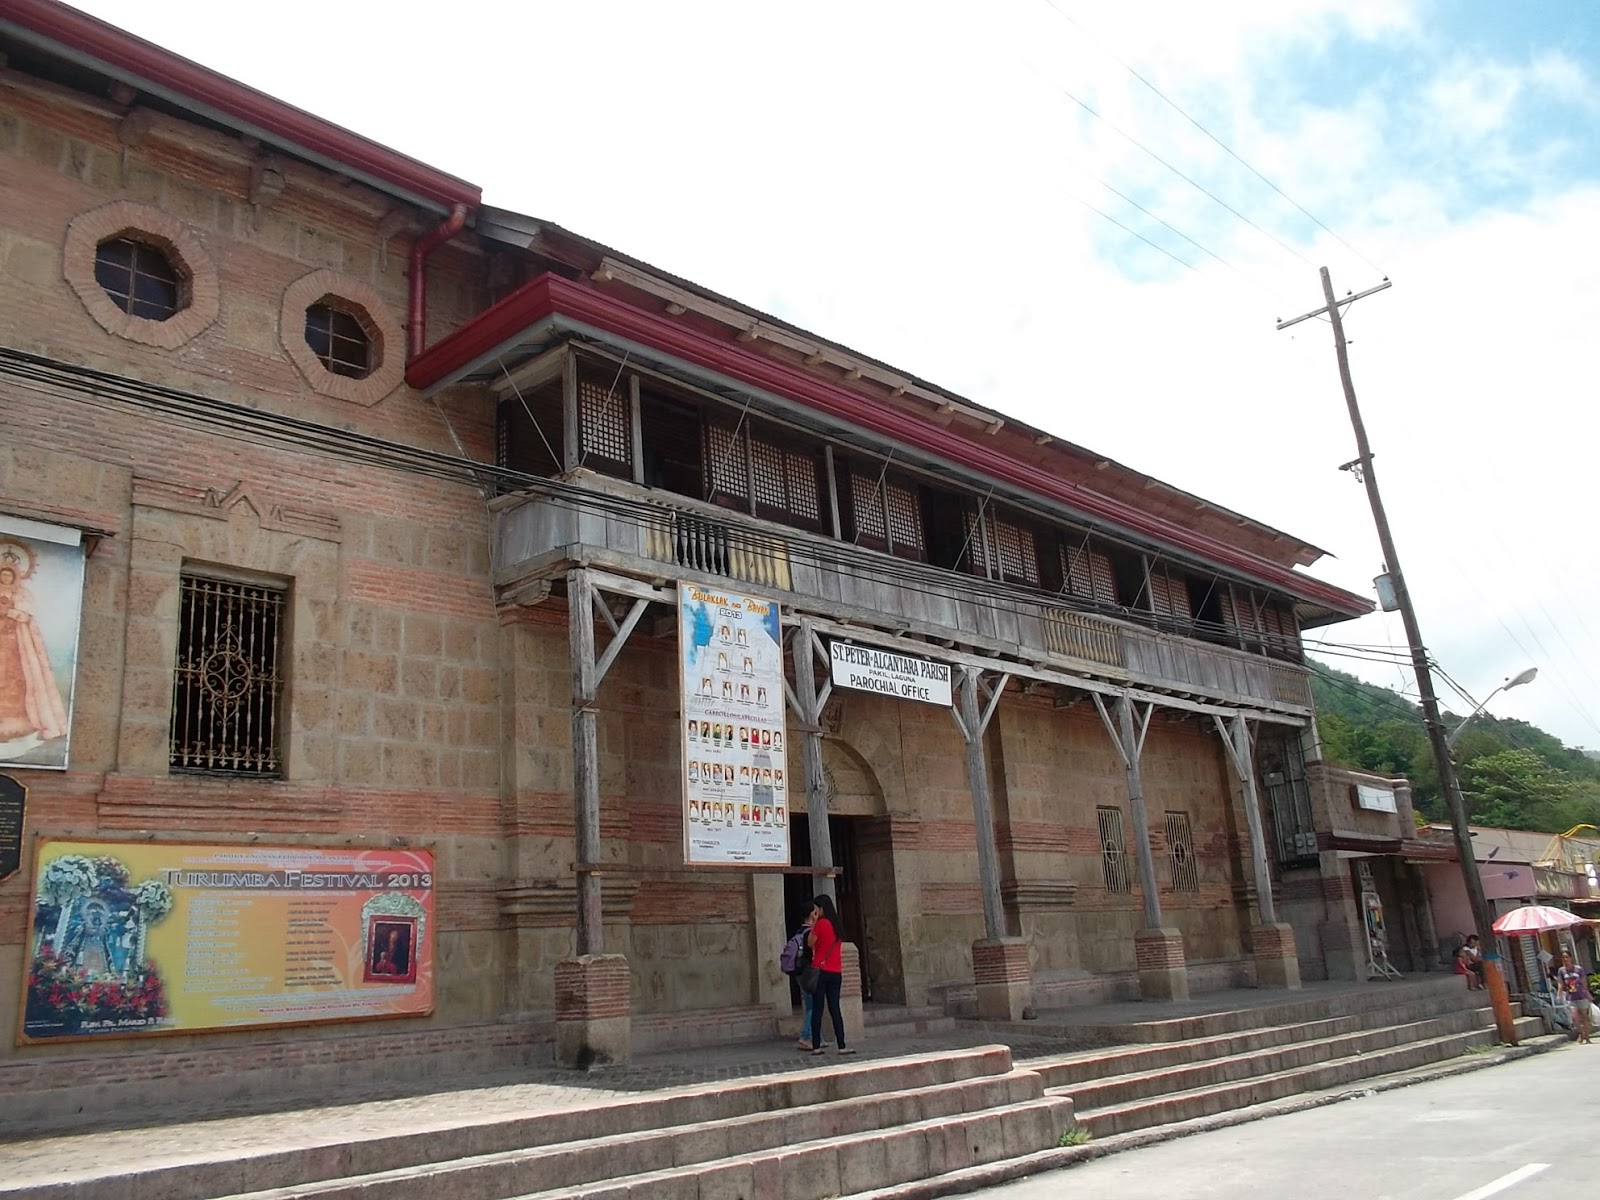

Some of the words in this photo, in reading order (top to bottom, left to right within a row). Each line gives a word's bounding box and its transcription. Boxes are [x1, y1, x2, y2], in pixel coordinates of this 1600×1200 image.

[720, 608, 742, 619] 2013
[833, 644, 845, 661] ST.
[845, 646, 871, 668] PETER
[874, 652, 919, 676] ALCANTARA
[920, 662, 948, 682] PARISH
[850, 674, 899, 694] PAROCHIAL
[901, 684, 930, 700] OFFICE
[891, 673, 916, 683] LAGUNA
[163, 868, 280, 888] TURUMBA
[284, 870, 384, 888] FESTIVAL
[388, 874, 432, 887] 2013
